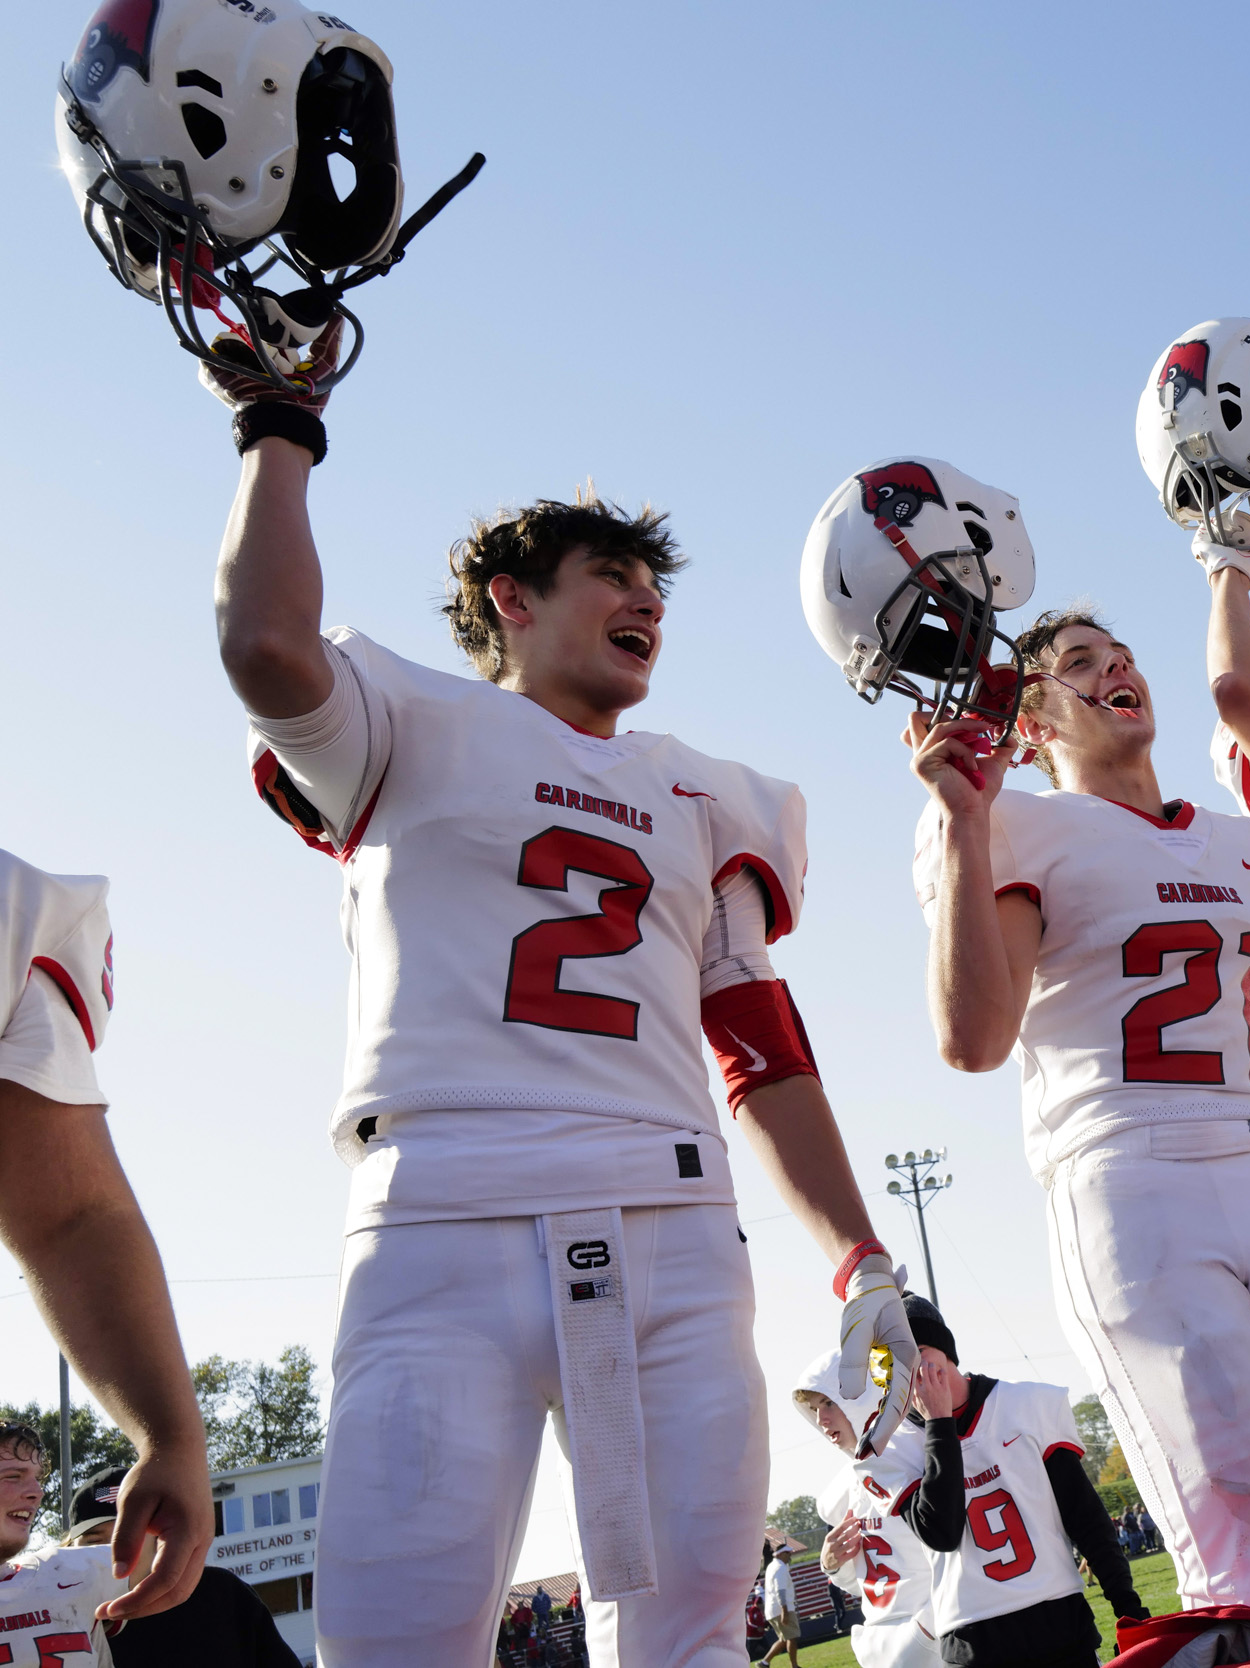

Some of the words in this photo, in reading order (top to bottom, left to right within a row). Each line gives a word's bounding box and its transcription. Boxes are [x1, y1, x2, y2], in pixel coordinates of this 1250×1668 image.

[535, 781, 653, 835] CARDINALS
[1156, 882, 1243, 905] CARDINALS
[502, 825, 654, 1041] 2
[217, 1534, 293, 1558] SWEETLAND
[966, 1488, 1036, 1582] 9
[259, 1558, 276, 1572] OF
[283, 1553, 305, 1567] THE
[863, 1535, 900, 1608] 6
